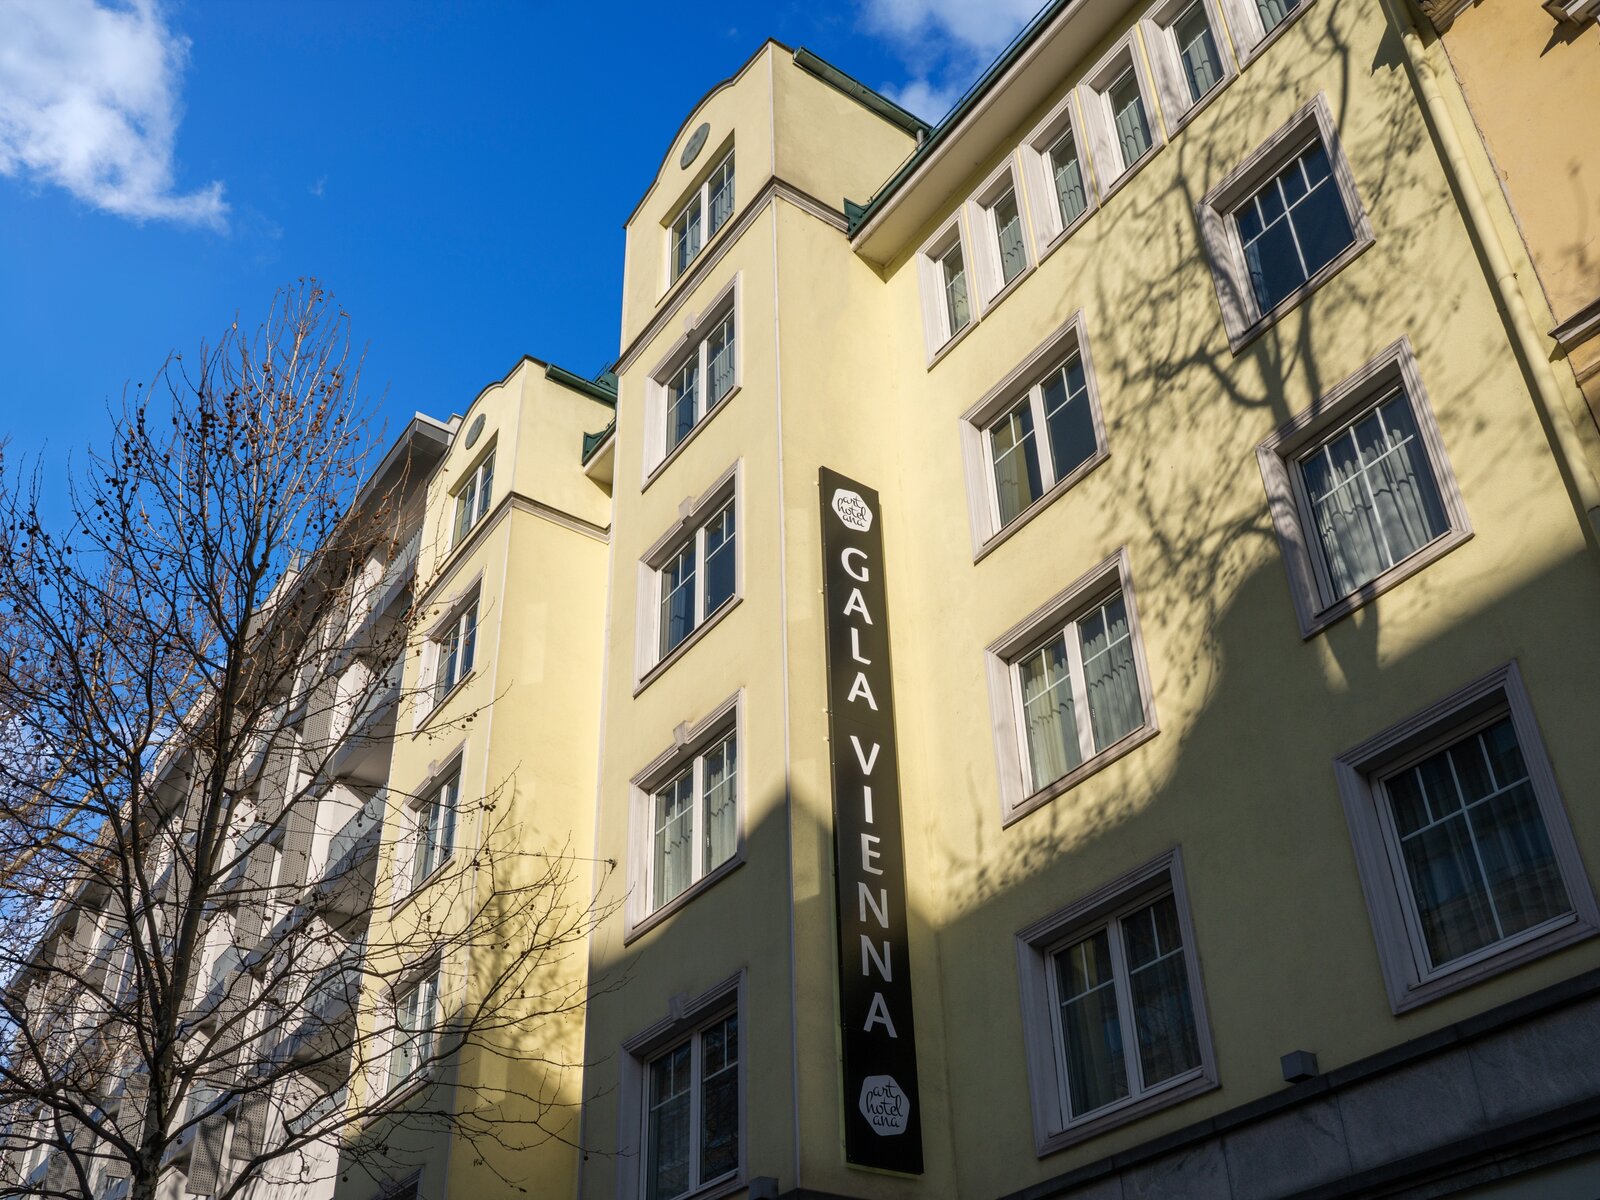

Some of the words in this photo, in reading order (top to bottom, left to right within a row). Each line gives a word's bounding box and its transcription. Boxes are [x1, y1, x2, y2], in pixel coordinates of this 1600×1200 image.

[837, 497, 867, 521] hotel
[842, 496, 862, 508] art
[842, 515, 864, 527] ana
[841, 547, 878, 711] GALA
[850, 735, 898, 1039] VIENNA
[873, 1080, 897, 1098] art
[866, 1091, 903, 1117] hotel
[872, 1115, 900, 1128] ana
